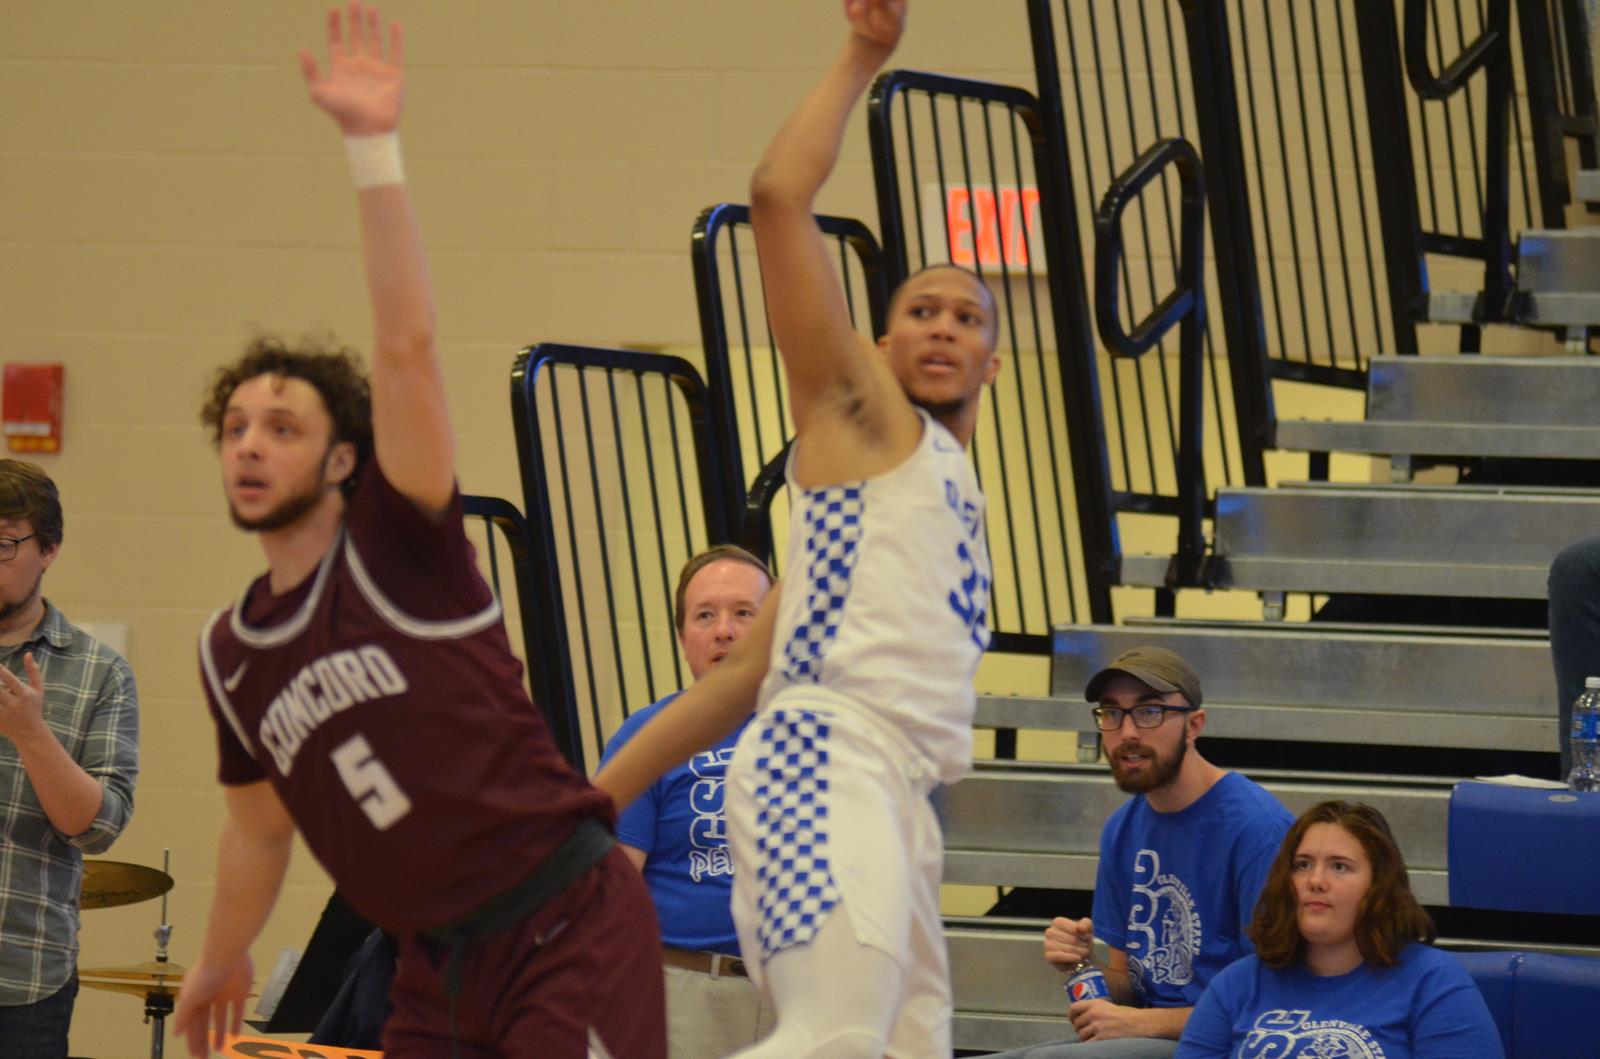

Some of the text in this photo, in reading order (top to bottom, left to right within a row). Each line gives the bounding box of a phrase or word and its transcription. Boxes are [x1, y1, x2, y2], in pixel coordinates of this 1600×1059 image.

[946, 187, 1040, 267] EXIT
[258, 644, 408, 778] CONCORD
[330, 732, 412, 831] 5
